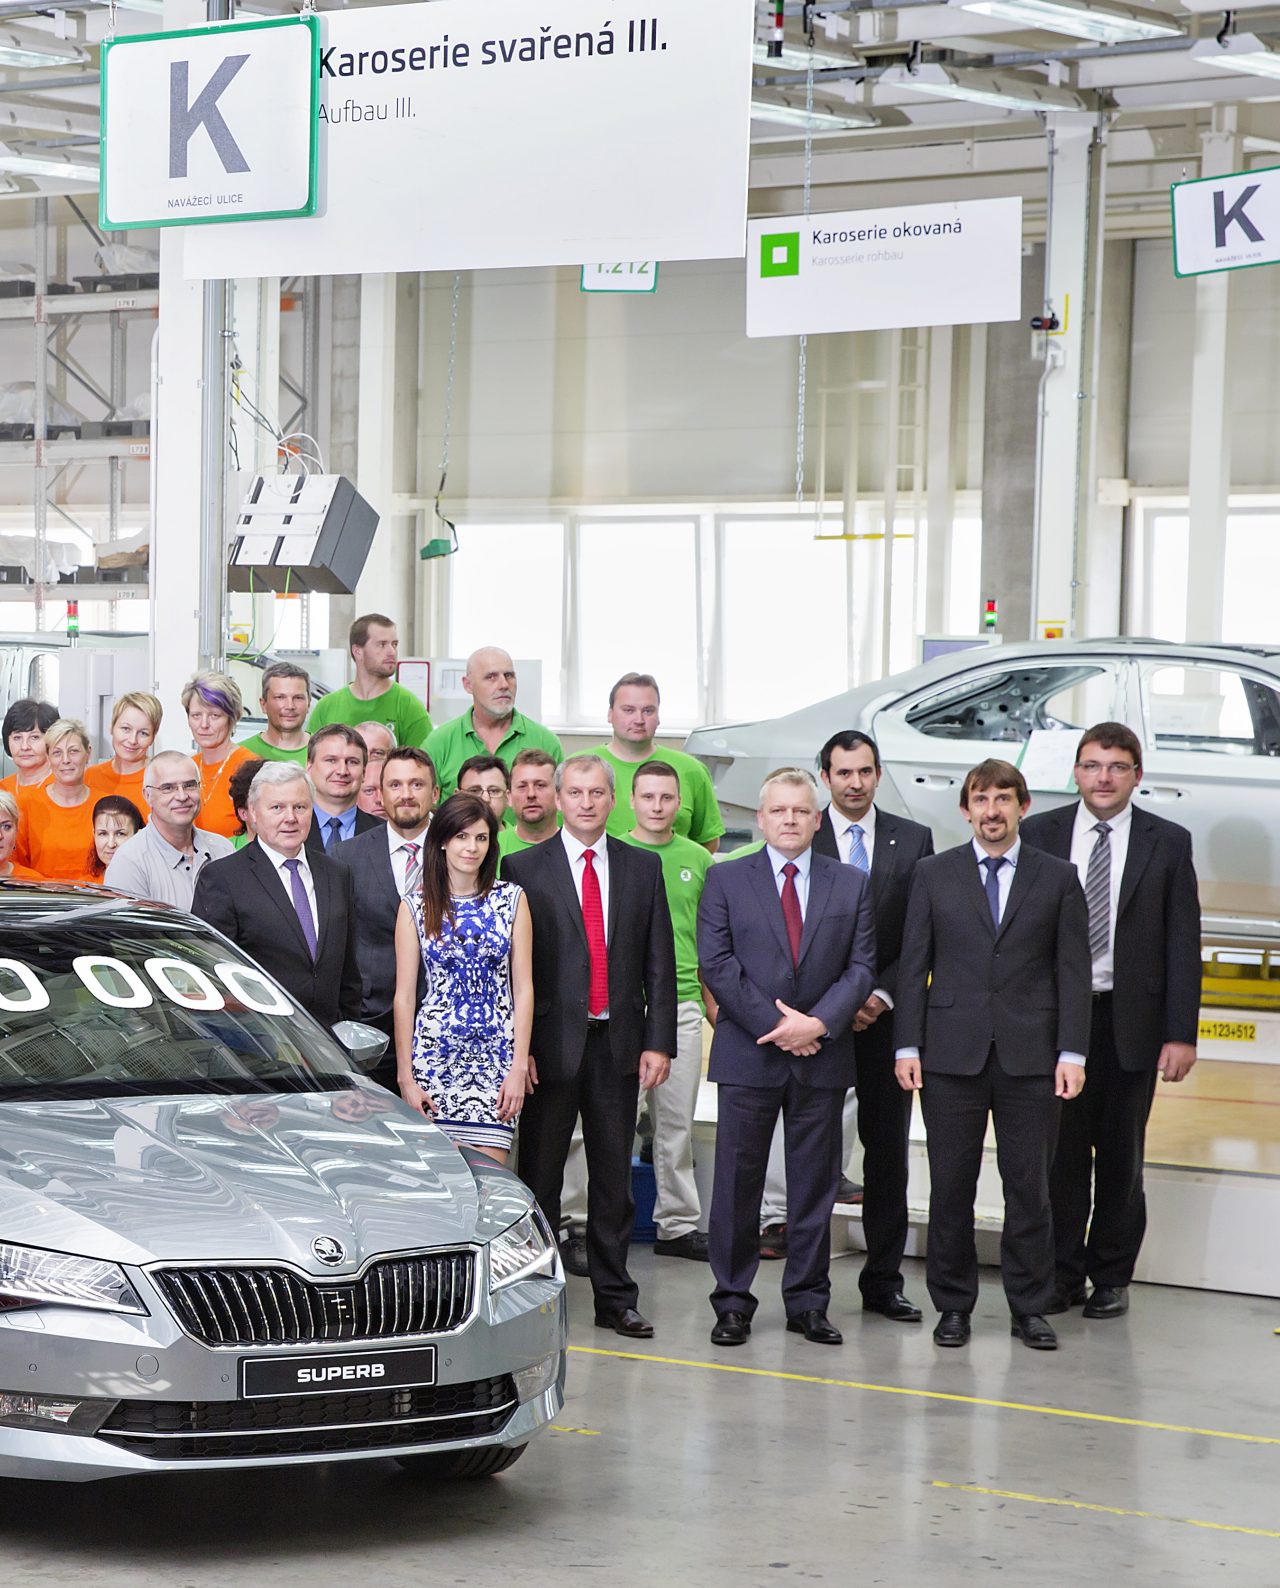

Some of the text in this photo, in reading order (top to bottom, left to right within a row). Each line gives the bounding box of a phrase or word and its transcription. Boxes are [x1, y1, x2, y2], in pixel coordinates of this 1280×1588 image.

[320, 18, 668, 79] Karoserie svařená III.
[169, 54, 251, 179] K
[318, 97, 417, 124] Aufbau III.
[167, 193, 244, 208] NAVÁŽECÍ ULICE
[1212, 184, 1265, 248] K
[812, 218, 962, 245] Karoserie okovaná
[811, 249, 904, 266] Karosserie rohbau
[72, 955, 295, 1016] 000
[297, 1363, 385, 1383] SUPERB
